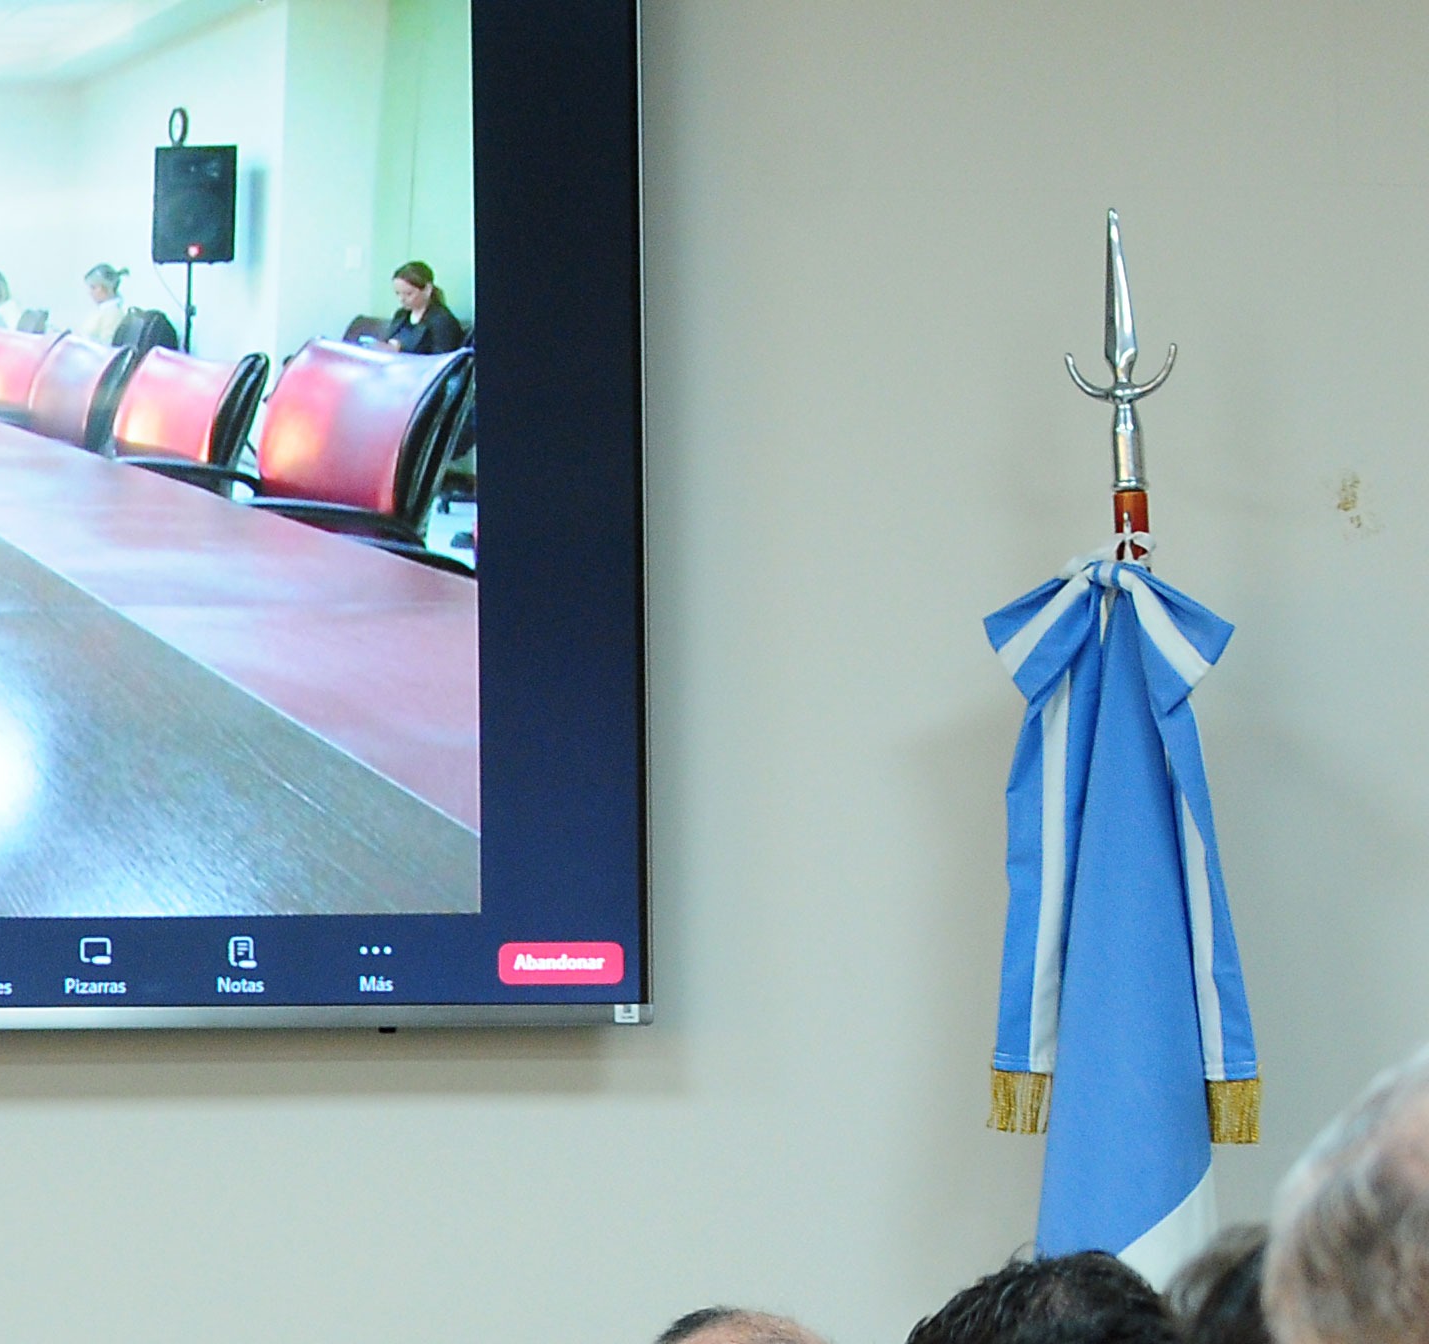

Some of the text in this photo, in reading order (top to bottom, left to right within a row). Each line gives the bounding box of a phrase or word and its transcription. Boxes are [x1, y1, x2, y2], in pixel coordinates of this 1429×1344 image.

[513, 953, 606, 971] Abandonar
[64, 977, 127, 994] Pizarras
[217, 976, 265, 993] Notas
[359, 975, 394, 992] Más
